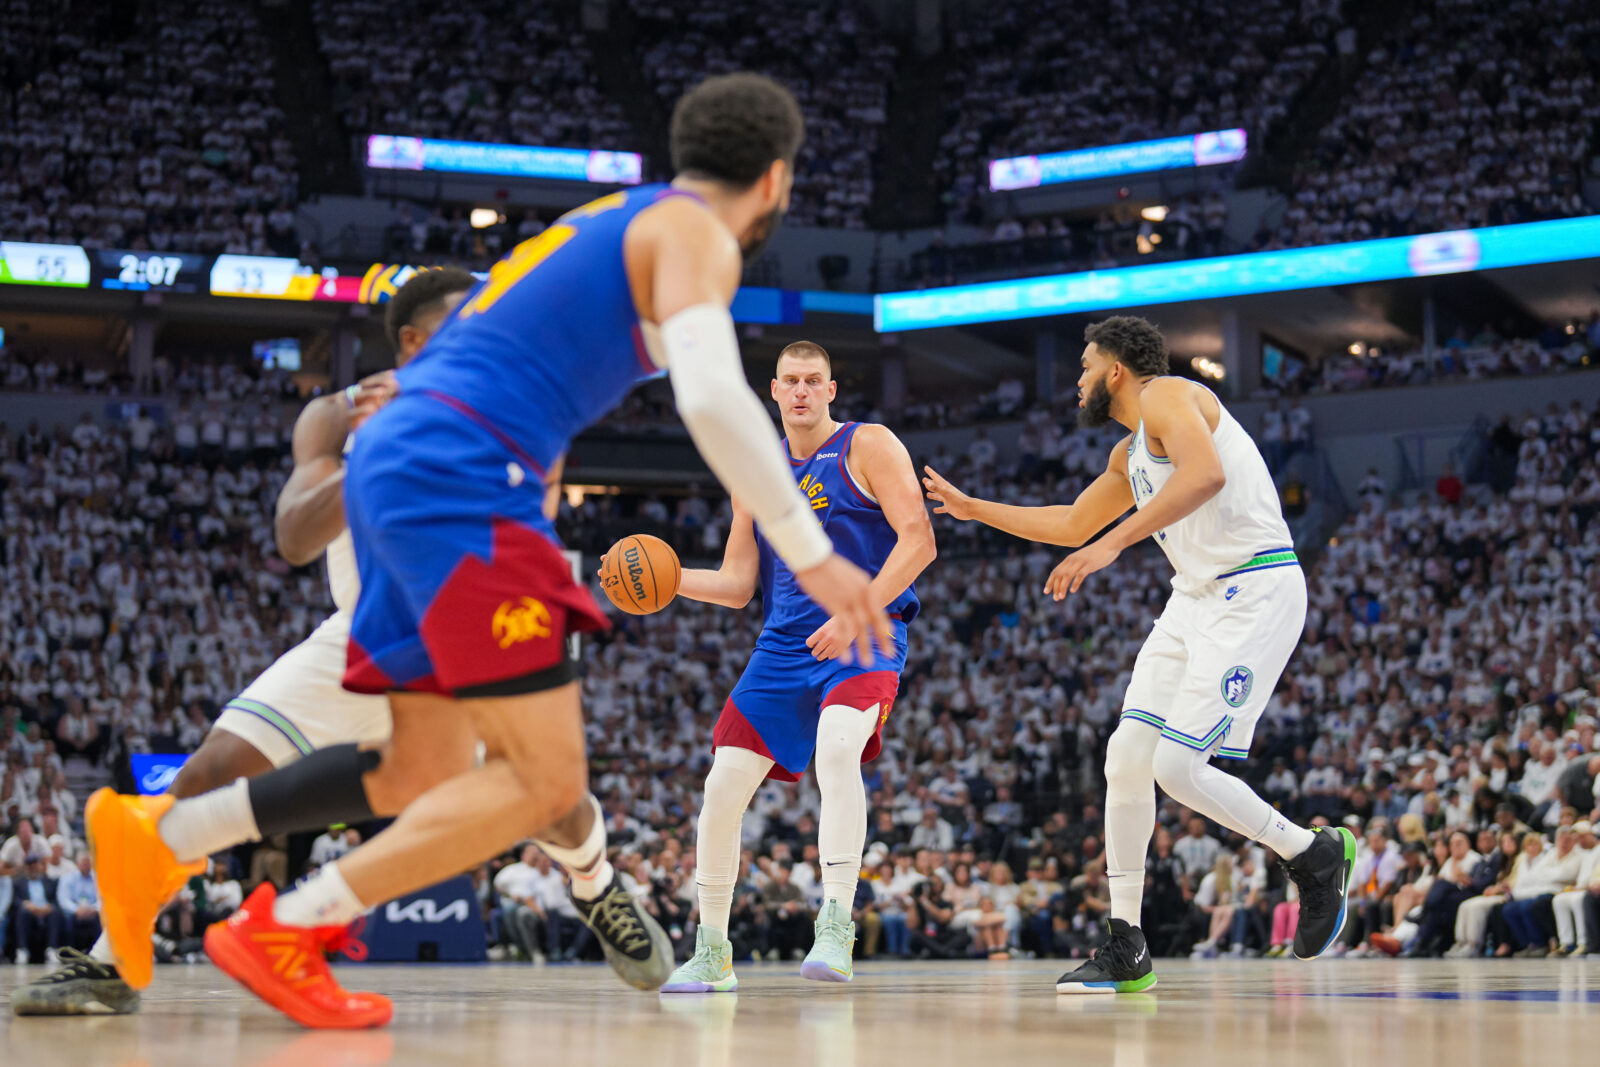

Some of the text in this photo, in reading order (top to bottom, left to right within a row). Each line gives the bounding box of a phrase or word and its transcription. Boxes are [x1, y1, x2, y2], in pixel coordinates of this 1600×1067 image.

[119, 254, 183, 286] 2:07
[235, 266, 263, 293] 33
[624, 546, 648, 601] Wilson
[385, 898, 468, 922] KIA
